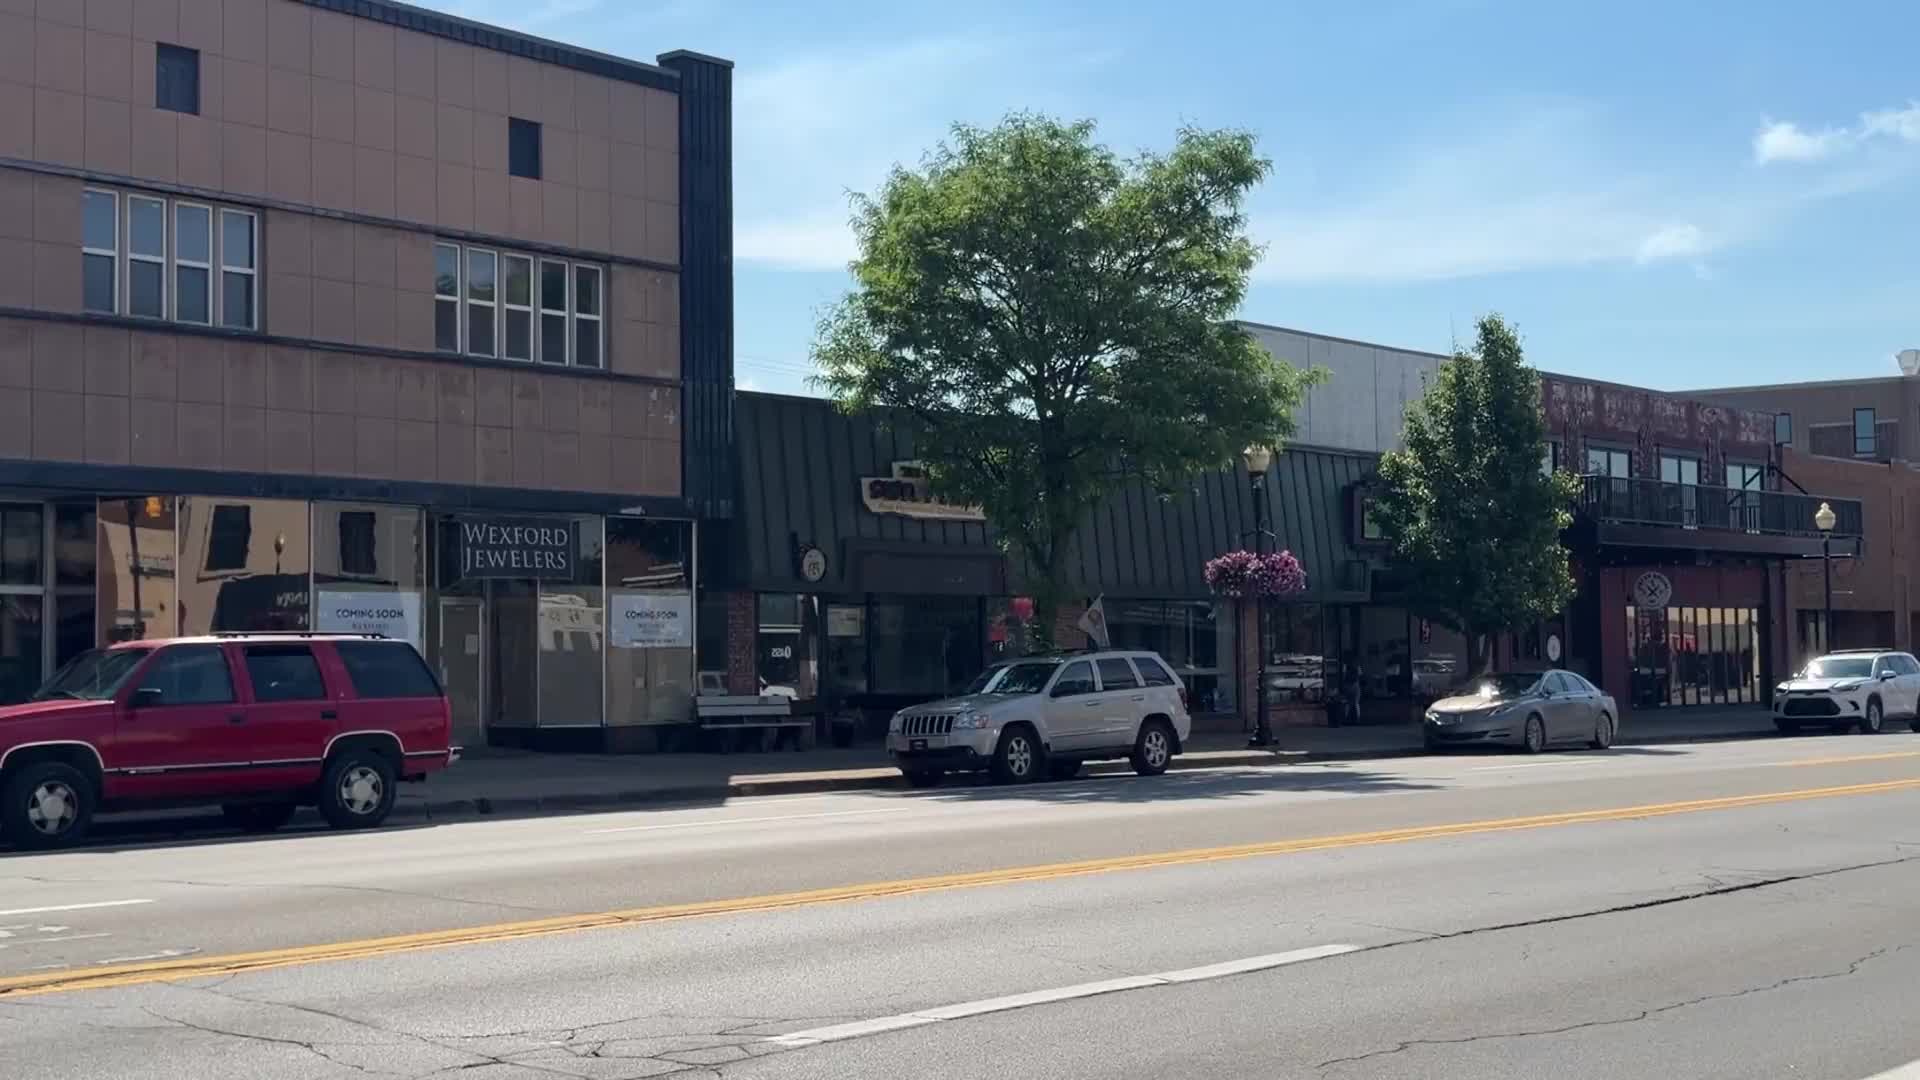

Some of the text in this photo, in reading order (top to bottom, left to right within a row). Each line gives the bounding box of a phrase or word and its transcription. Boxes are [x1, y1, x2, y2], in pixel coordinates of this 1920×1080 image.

[463, 522, 569, 546] WEXFORD
[464, 547, 567, 573] JEWELERS
[335, 608, 405, 619] COMING SOON
